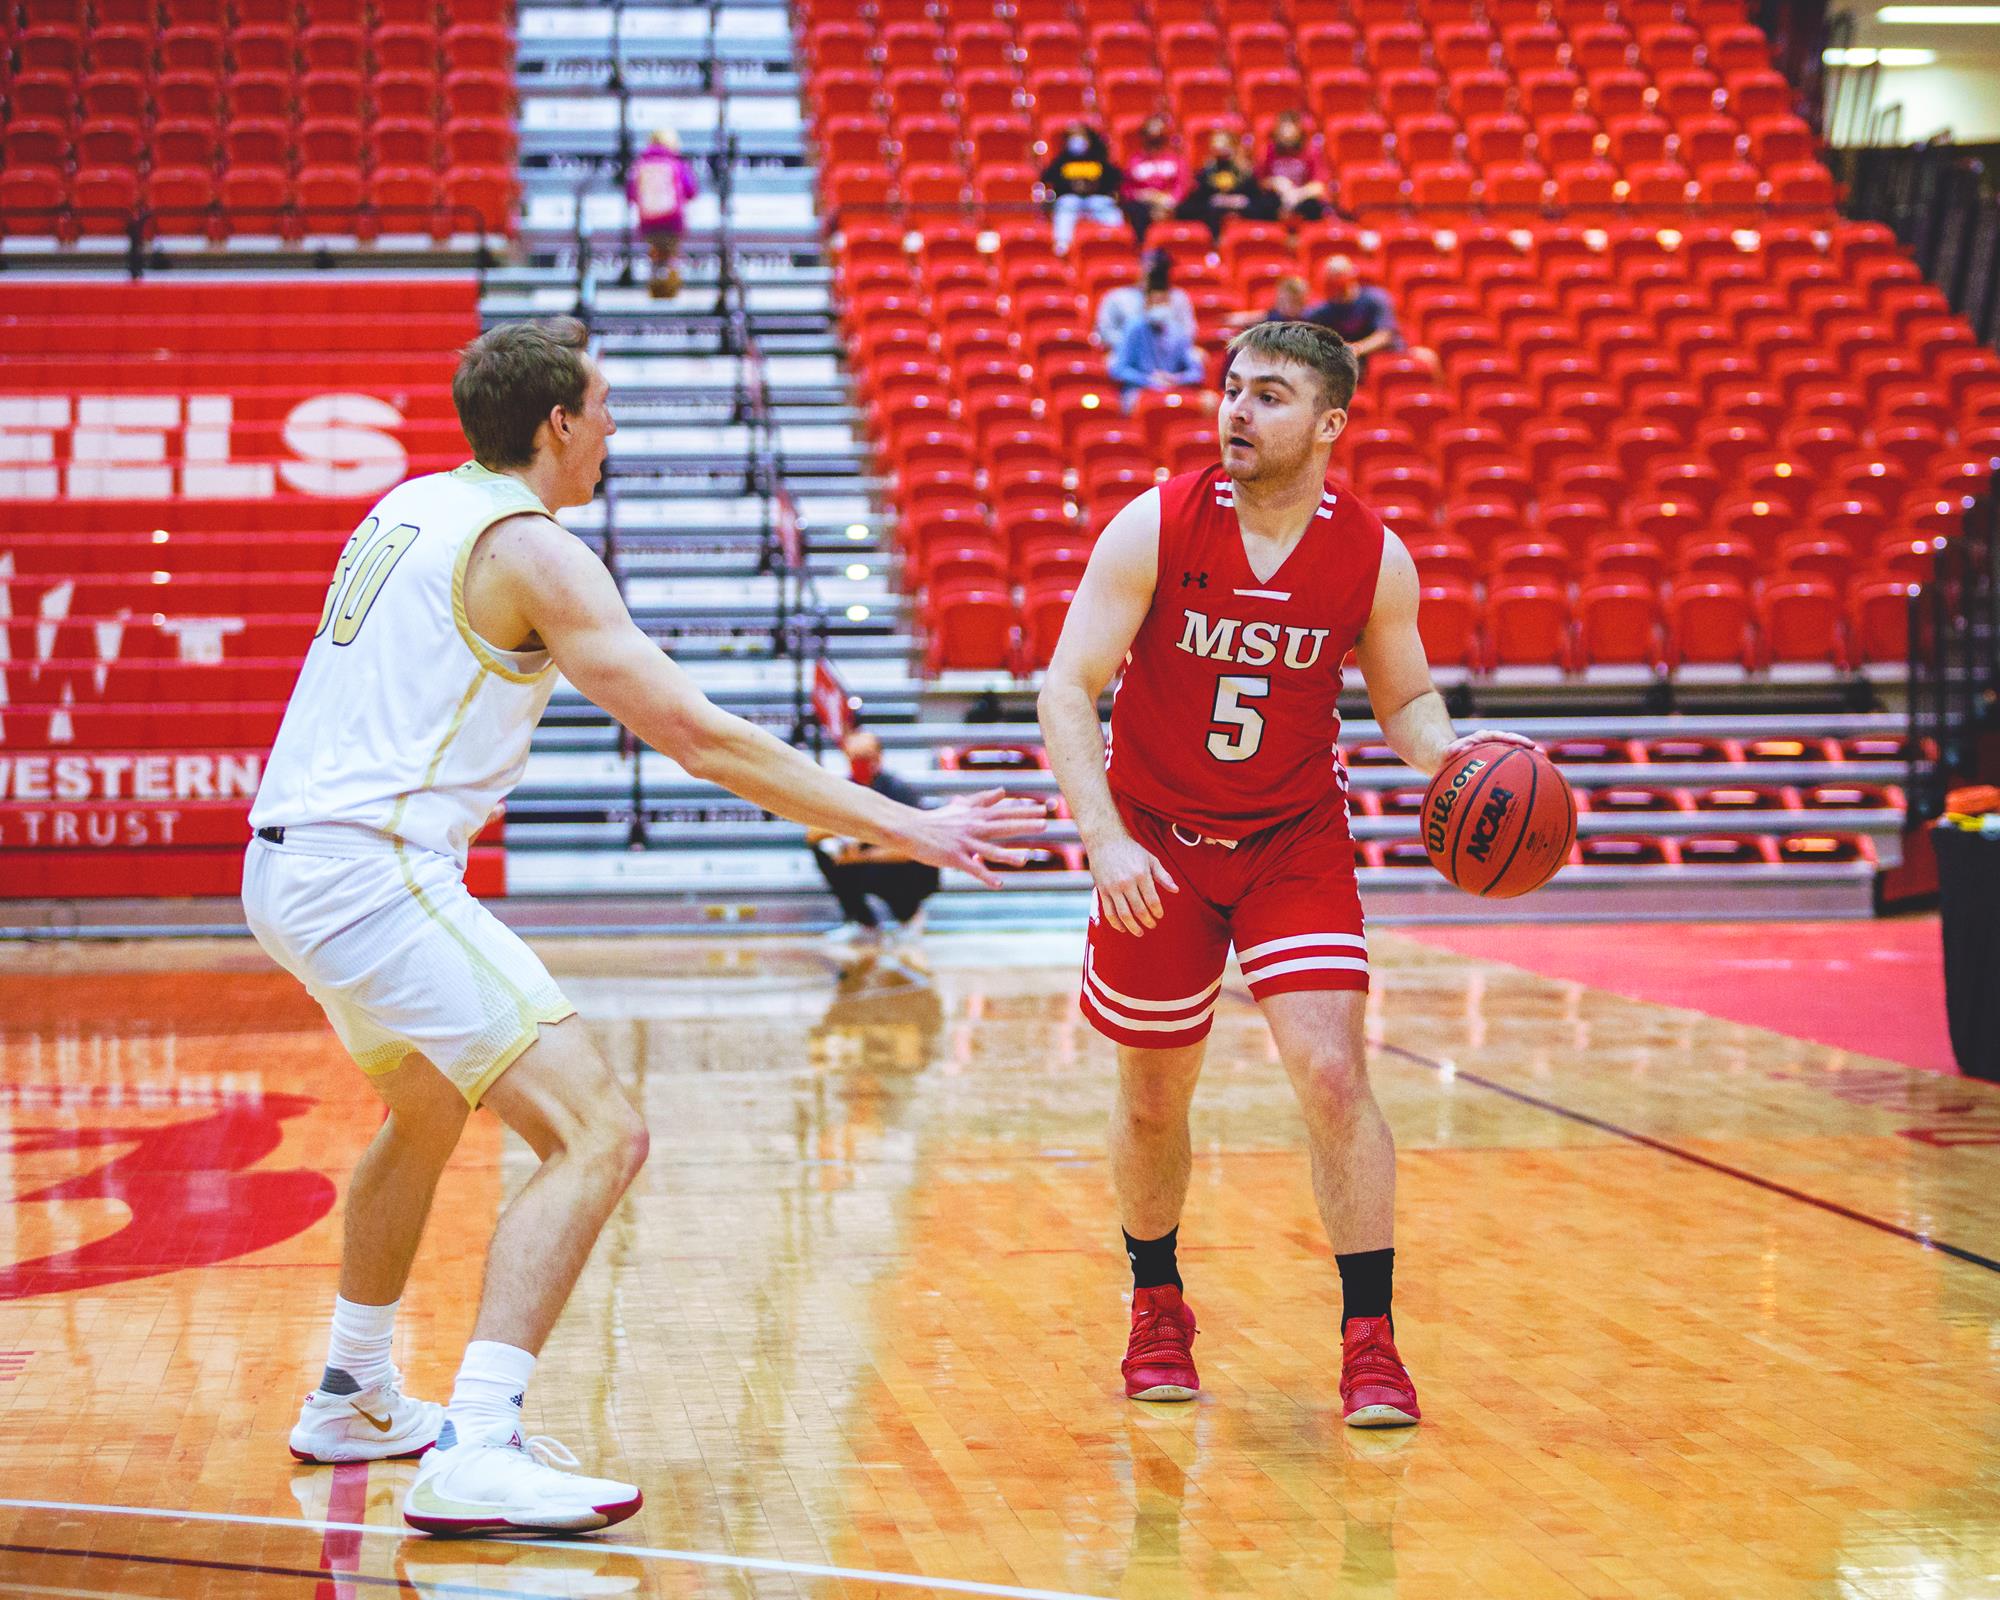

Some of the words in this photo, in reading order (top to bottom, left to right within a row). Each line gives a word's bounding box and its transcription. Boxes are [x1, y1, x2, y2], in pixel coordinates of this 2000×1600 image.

[1175, 608, 1330, 670] MSU
[1204, 674, 1271, 763] 5
[0, 755, 260, 800] ESTERN
[1428, 759, 1488, 854] Wilson
[22, 811, 181, 847] TRUST
[1466, 786, 1514, 864] NCAA
